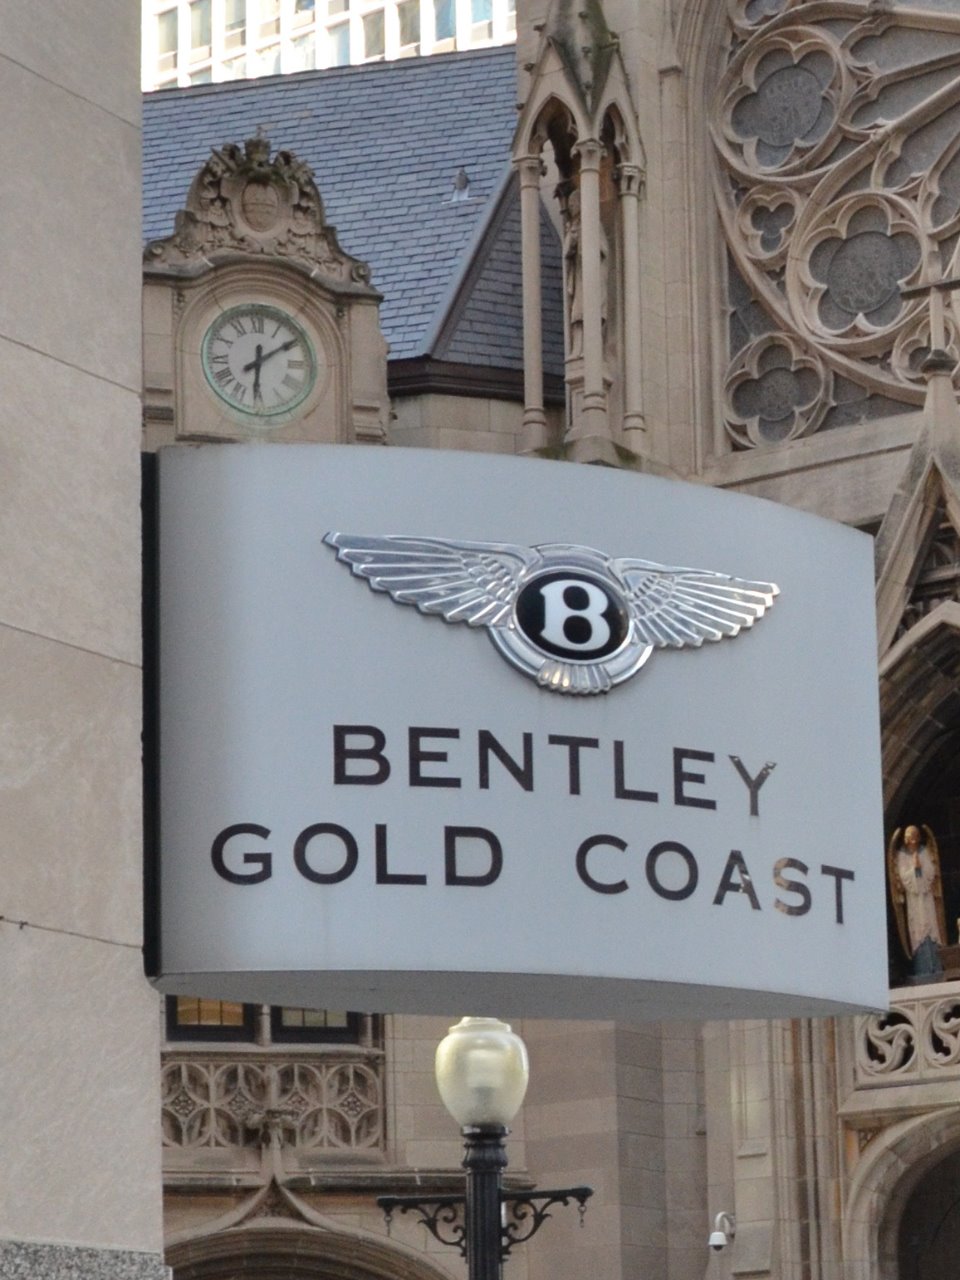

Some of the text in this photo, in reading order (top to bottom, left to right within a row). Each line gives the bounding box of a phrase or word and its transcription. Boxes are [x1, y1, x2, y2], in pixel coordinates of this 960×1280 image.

[541, 579, 611, 652] B
[333, 725, 777, 817] BENTLEY
[211, 823, 855, 925] GOLD COAST
